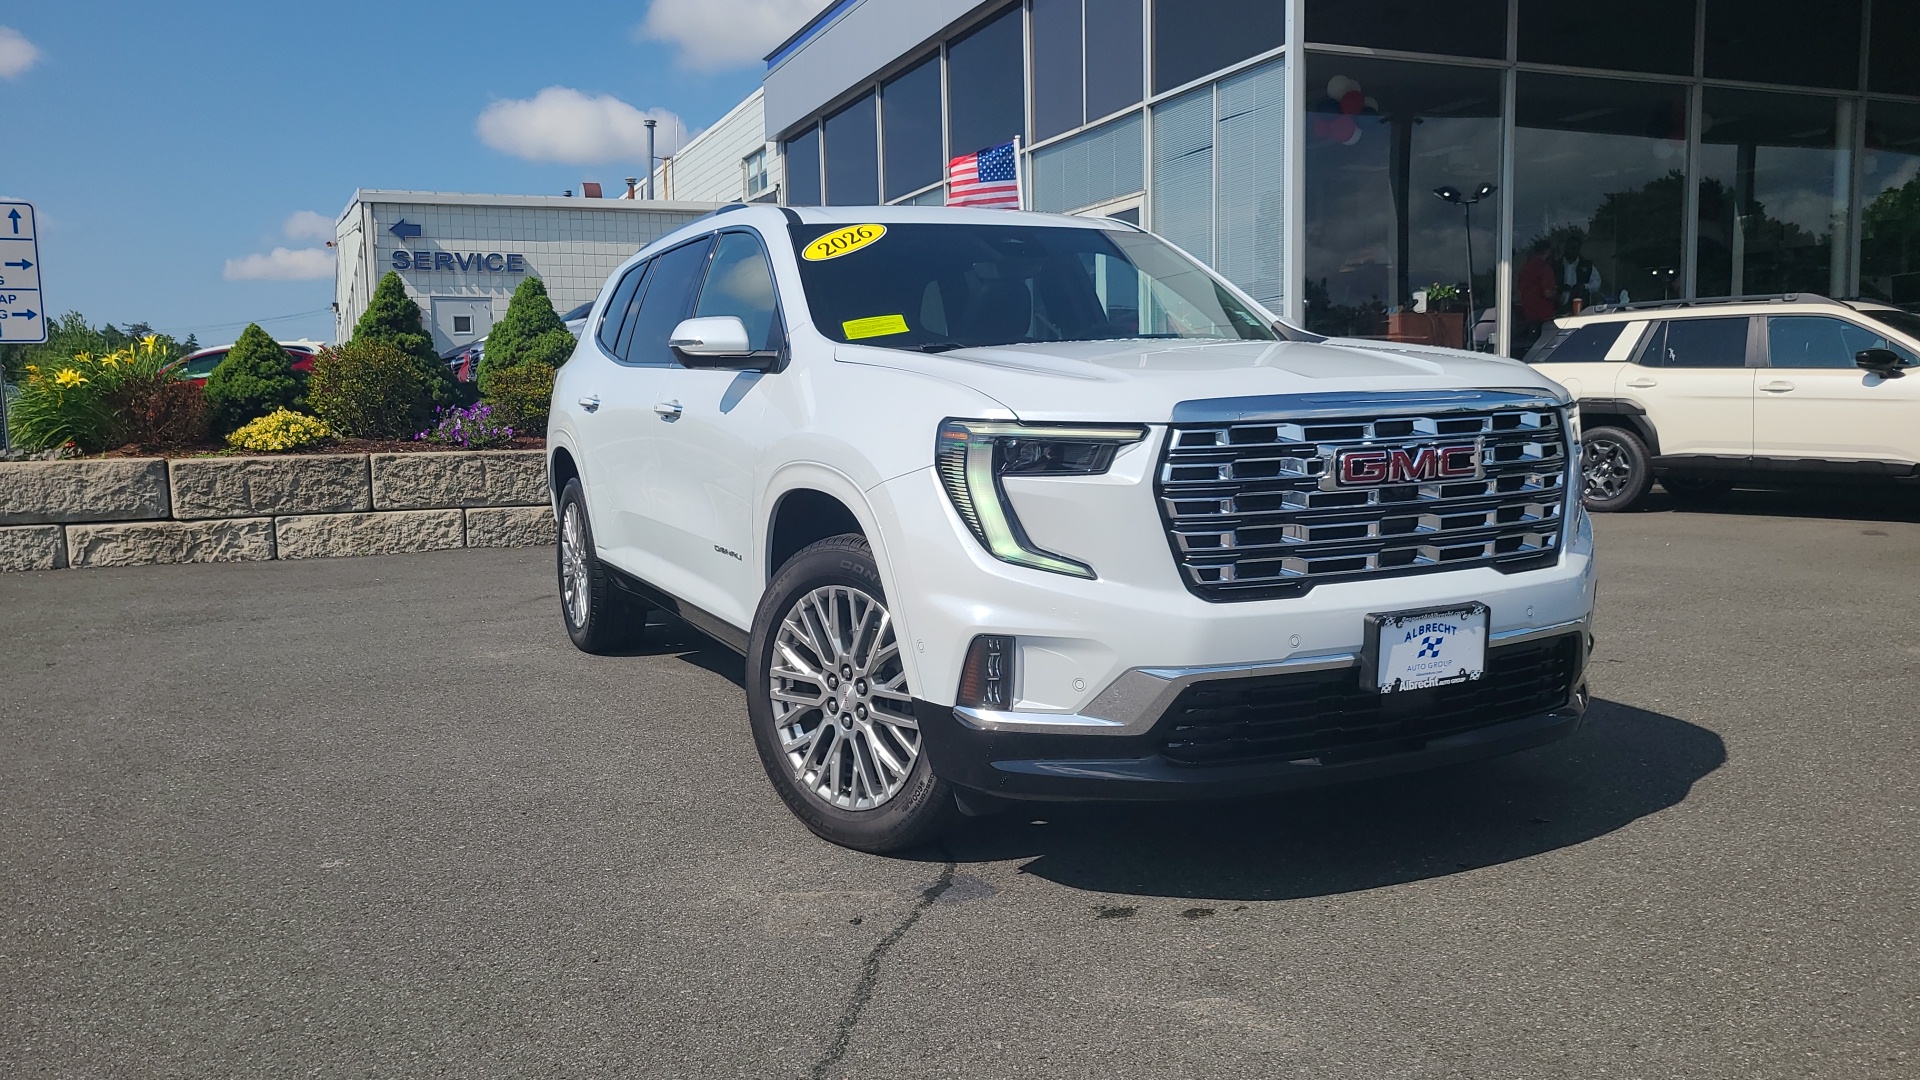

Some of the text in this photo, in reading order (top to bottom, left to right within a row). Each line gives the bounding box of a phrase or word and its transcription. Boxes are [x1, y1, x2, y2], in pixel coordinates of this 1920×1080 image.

[817, 226, 873, 257] 2026
[391, 250, 525, 273] SERVICE
[1340, 446, 1476, 484] GMC
[1404, 623, 1458, 642] ALBRECHT
[1407, 660, 1453, 672] AUTO GROUP
[1399, 676, 1439, 692] Albrecht
